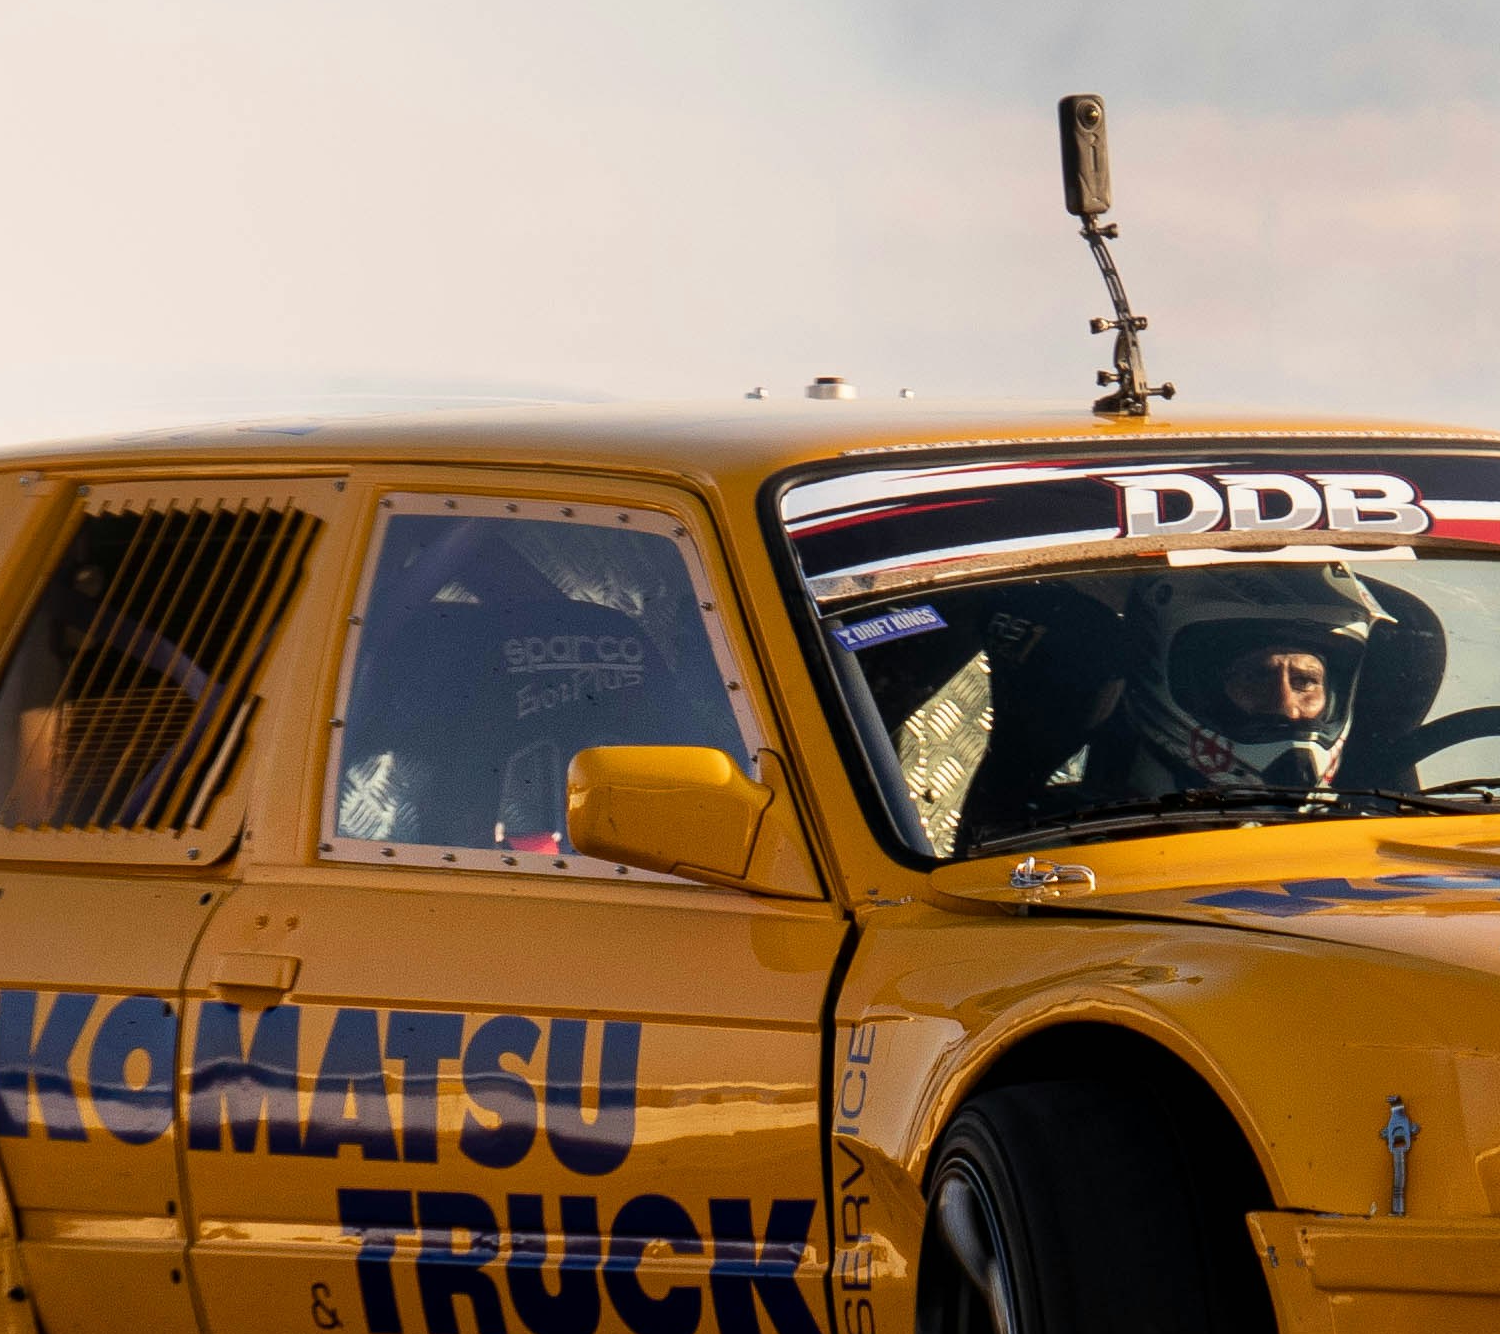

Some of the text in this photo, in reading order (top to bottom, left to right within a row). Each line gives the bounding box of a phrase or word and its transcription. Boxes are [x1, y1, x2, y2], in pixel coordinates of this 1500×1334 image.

[1102, 472, 1433, 536] DDB
[851, 609, 938, 642] DRIFT KINGS
[503, 635, 644, 669] sparco
[310, 1282, 344, 1330] &
